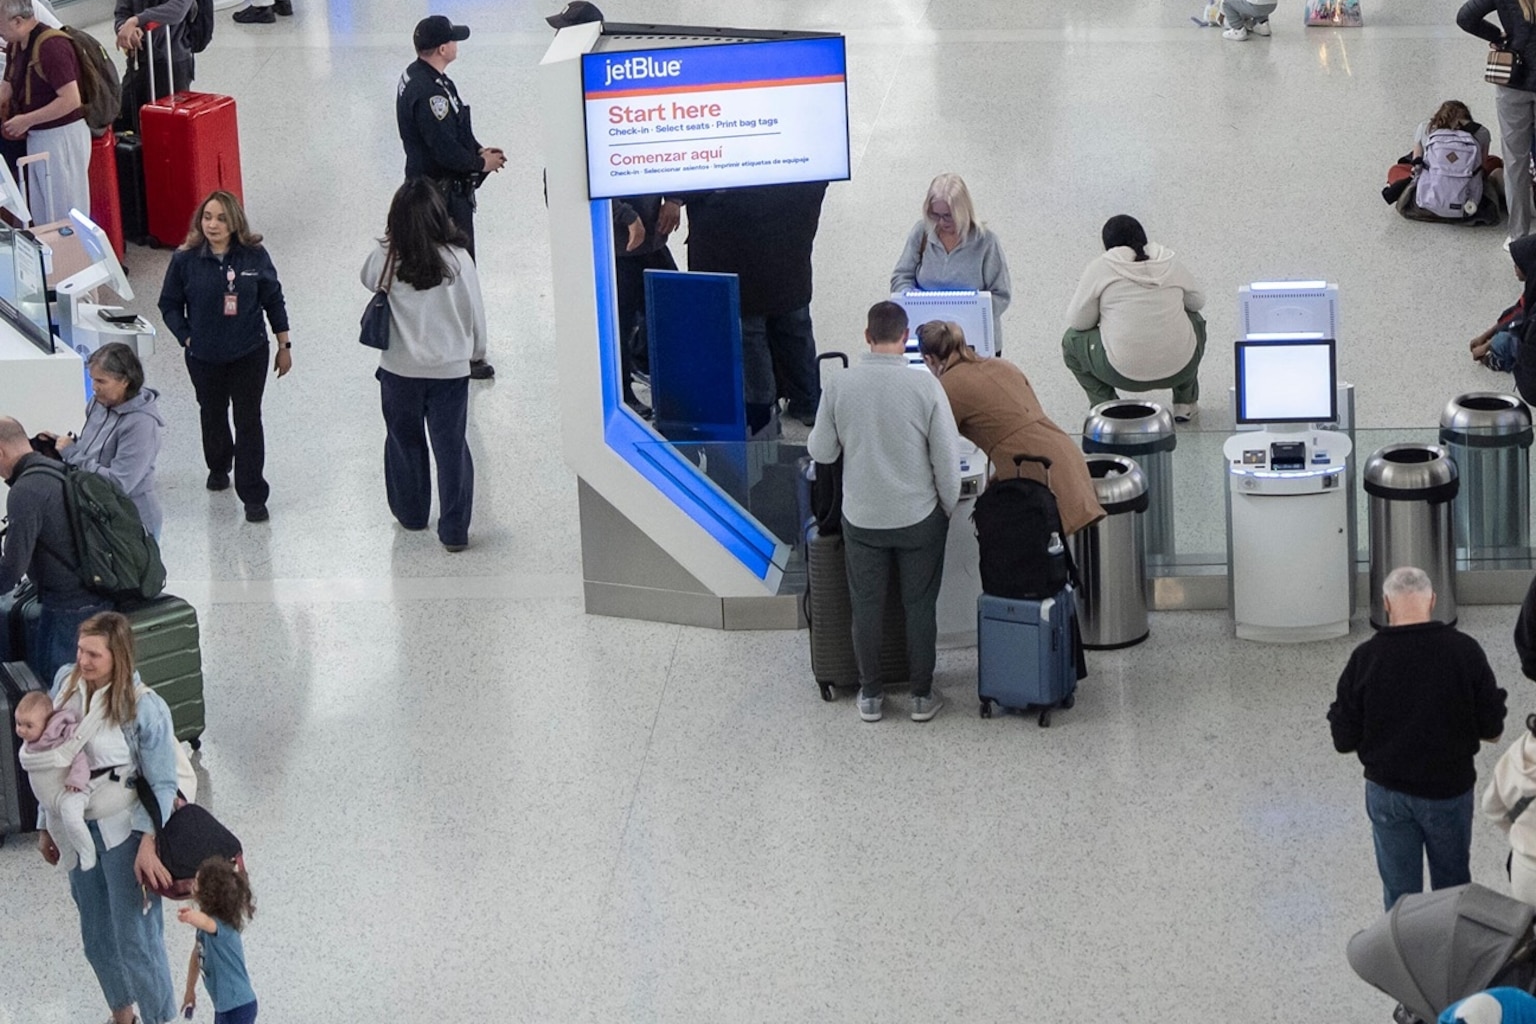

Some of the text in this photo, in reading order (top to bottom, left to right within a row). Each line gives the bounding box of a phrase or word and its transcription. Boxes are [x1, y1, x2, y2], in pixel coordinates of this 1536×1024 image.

[605, 56, 682, 85] jetBlue
[608, 102, 721, 124] Start here
[608, 116, 779, 137] Check-in Select seats Print bag tags
[609, 145, 724, 167] Comenzar aquí
[609, 168, 640, 177] Check-in
[643, 165, 682, 176] Seleccionar
[772, 157, 782, 165] de
